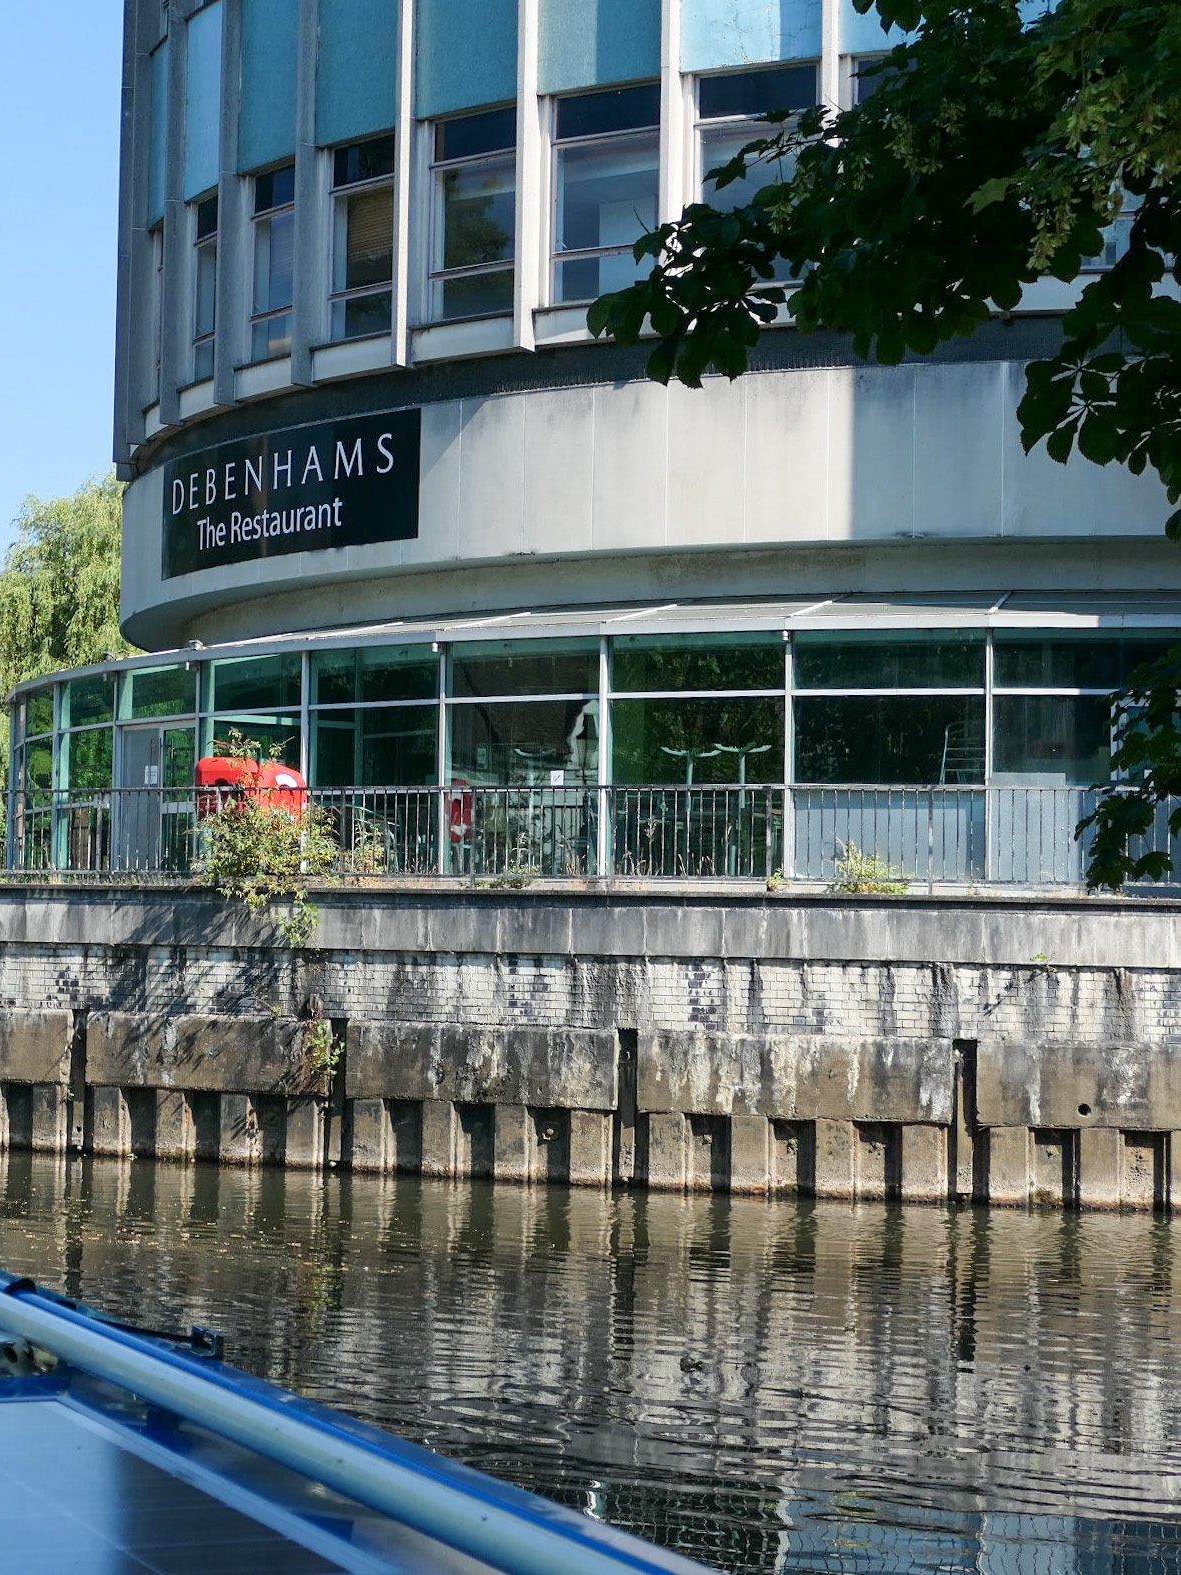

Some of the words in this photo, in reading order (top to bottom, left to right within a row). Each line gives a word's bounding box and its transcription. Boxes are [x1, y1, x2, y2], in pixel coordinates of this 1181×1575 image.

[172, 433, 394, 515] DEBENHAMS
[197, 516, 226, 550] The
[230, 497, 343, 543] Restaurant
